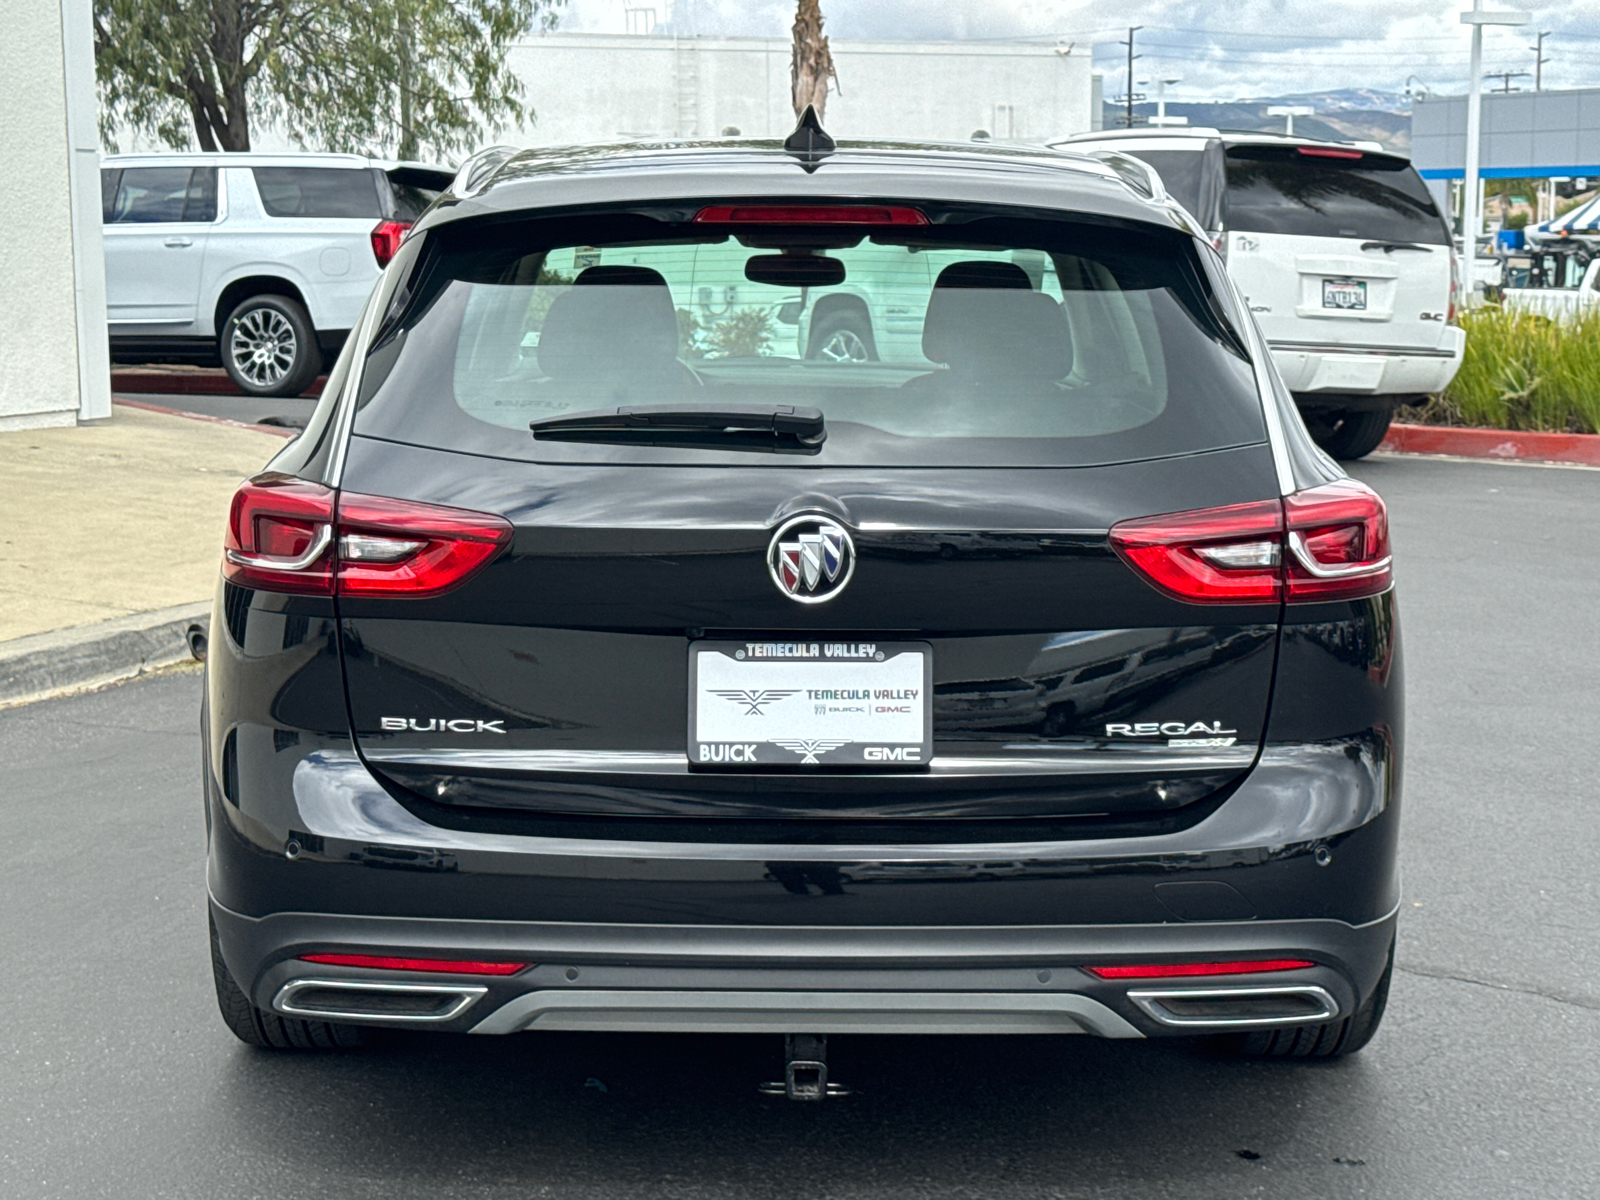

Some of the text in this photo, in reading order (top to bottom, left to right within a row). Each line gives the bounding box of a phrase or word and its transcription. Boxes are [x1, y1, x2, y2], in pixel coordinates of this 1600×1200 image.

[746, 643, 876, 658] TEMECULA VALLEY
[806, 689, 919, 700] TEMECULA VALLEY
[380, 716, 507, 734] BUICK
[1105, 720, 1238, 737] REGAL
[699, 744, 758, 762] BUICK
[863, 747, 922, 761] GMC
